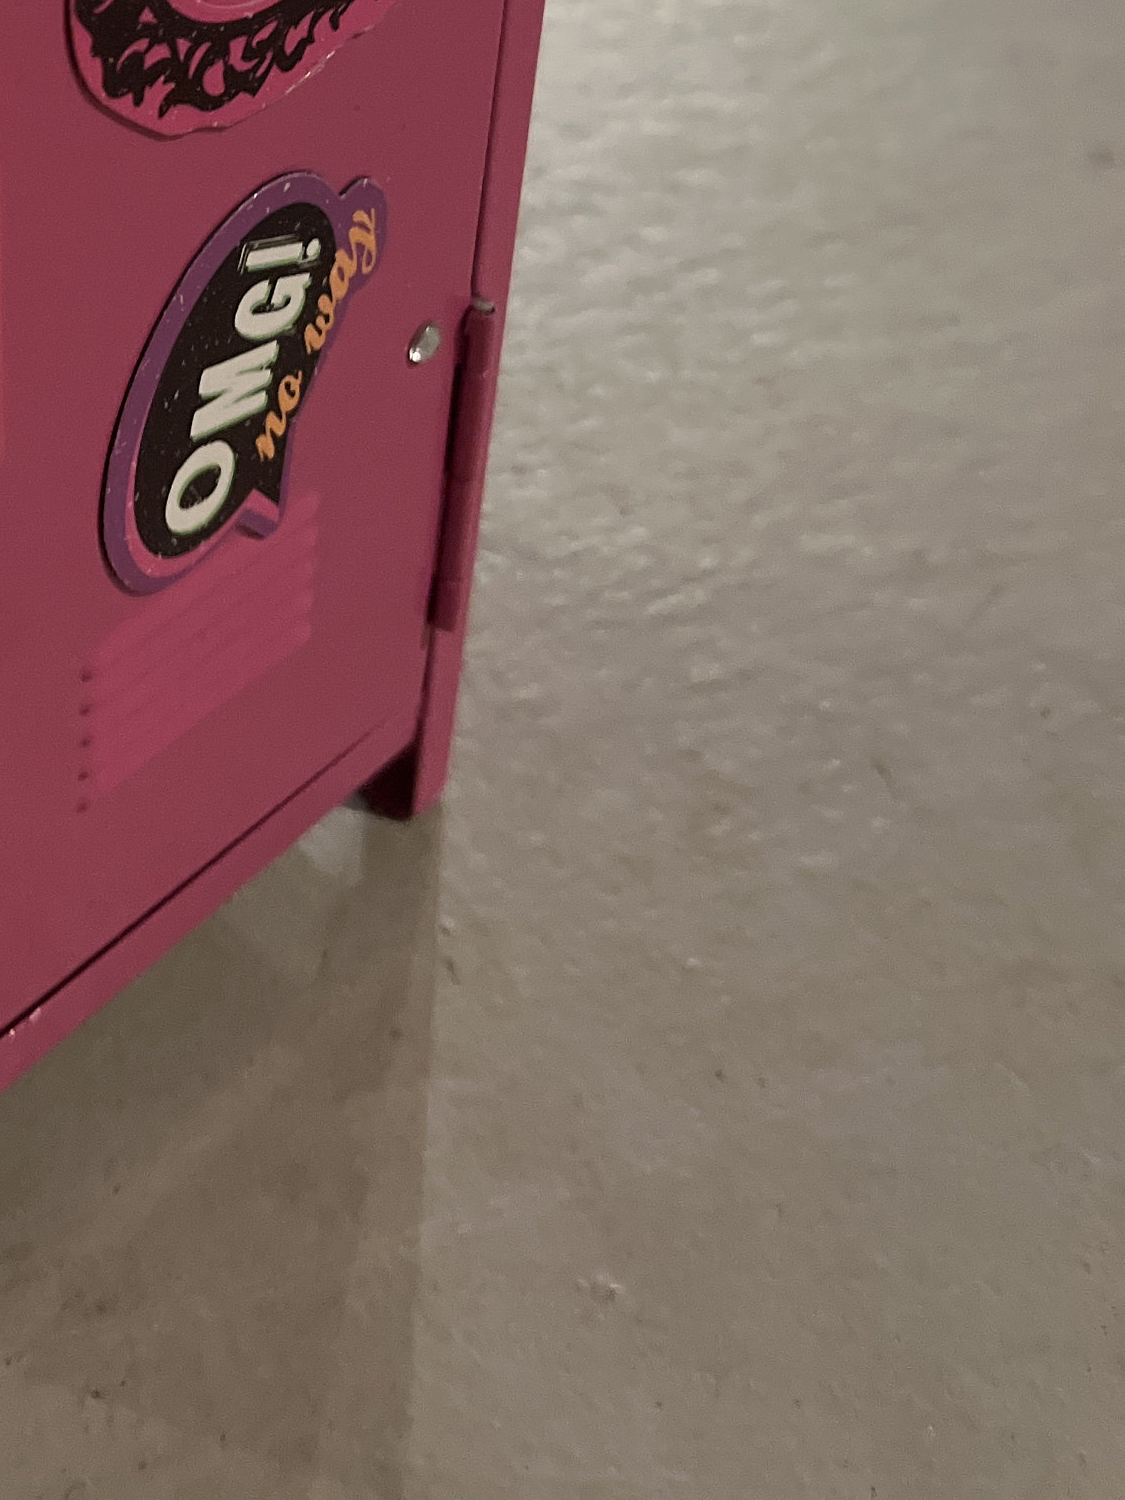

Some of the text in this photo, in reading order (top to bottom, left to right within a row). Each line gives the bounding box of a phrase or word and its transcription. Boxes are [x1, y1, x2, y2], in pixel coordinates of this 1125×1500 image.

[164, 237, 321, 535] OMG!
[255, 208, 377, 462] no way
